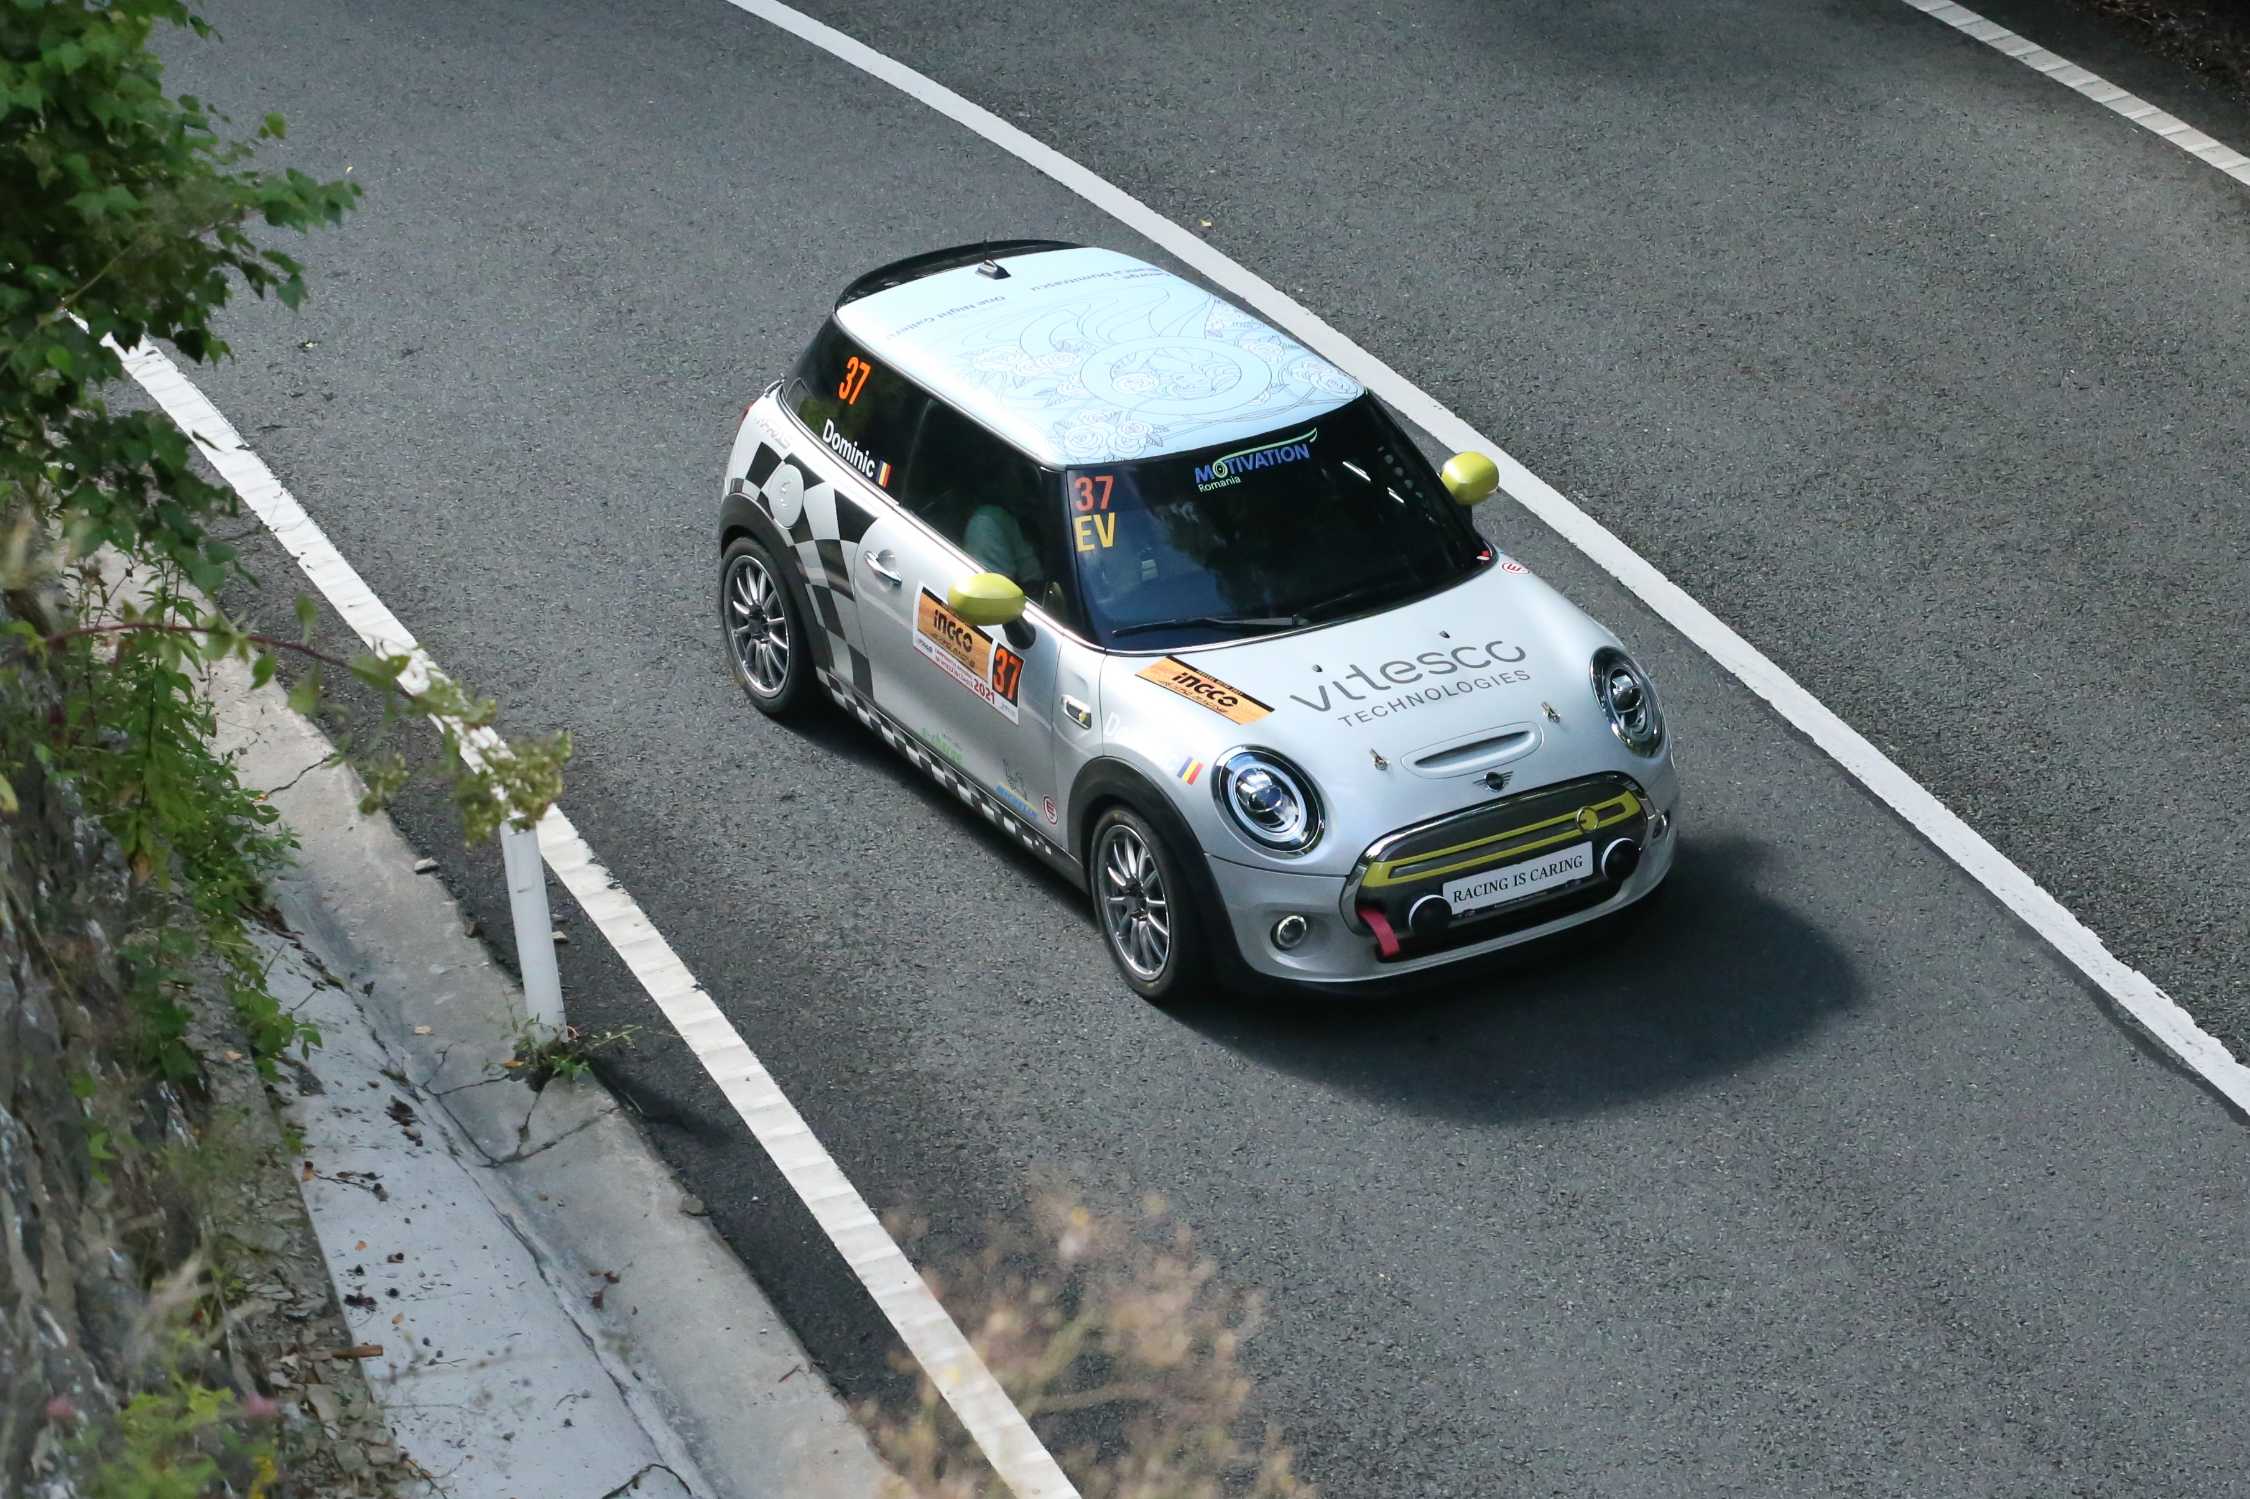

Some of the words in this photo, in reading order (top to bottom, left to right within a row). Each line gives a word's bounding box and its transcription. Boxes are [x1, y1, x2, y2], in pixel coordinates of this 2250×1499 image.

[838, 356, 872, 405] 37
[822, 418, 876, 478] Dominic
[1194, 443, 1310, 484] MOTIVATION
[1074, 475, 1114, 511] 37
[1198, 475, 1241, 493] Romania
[1074, 512, 1115, 552] EV
[973, 678, 995, 704] 2021
[993, 648, 1023, 700] 37
[1289, 640, 1527, 712] vitesco
[1337, 669, 1531, 728] TECHNOLOGIES
[1453, 877, 1508, 903] RACING
[1512, 872, 1527, 887] IS
[1530, 855, 1583, 881] CARING
